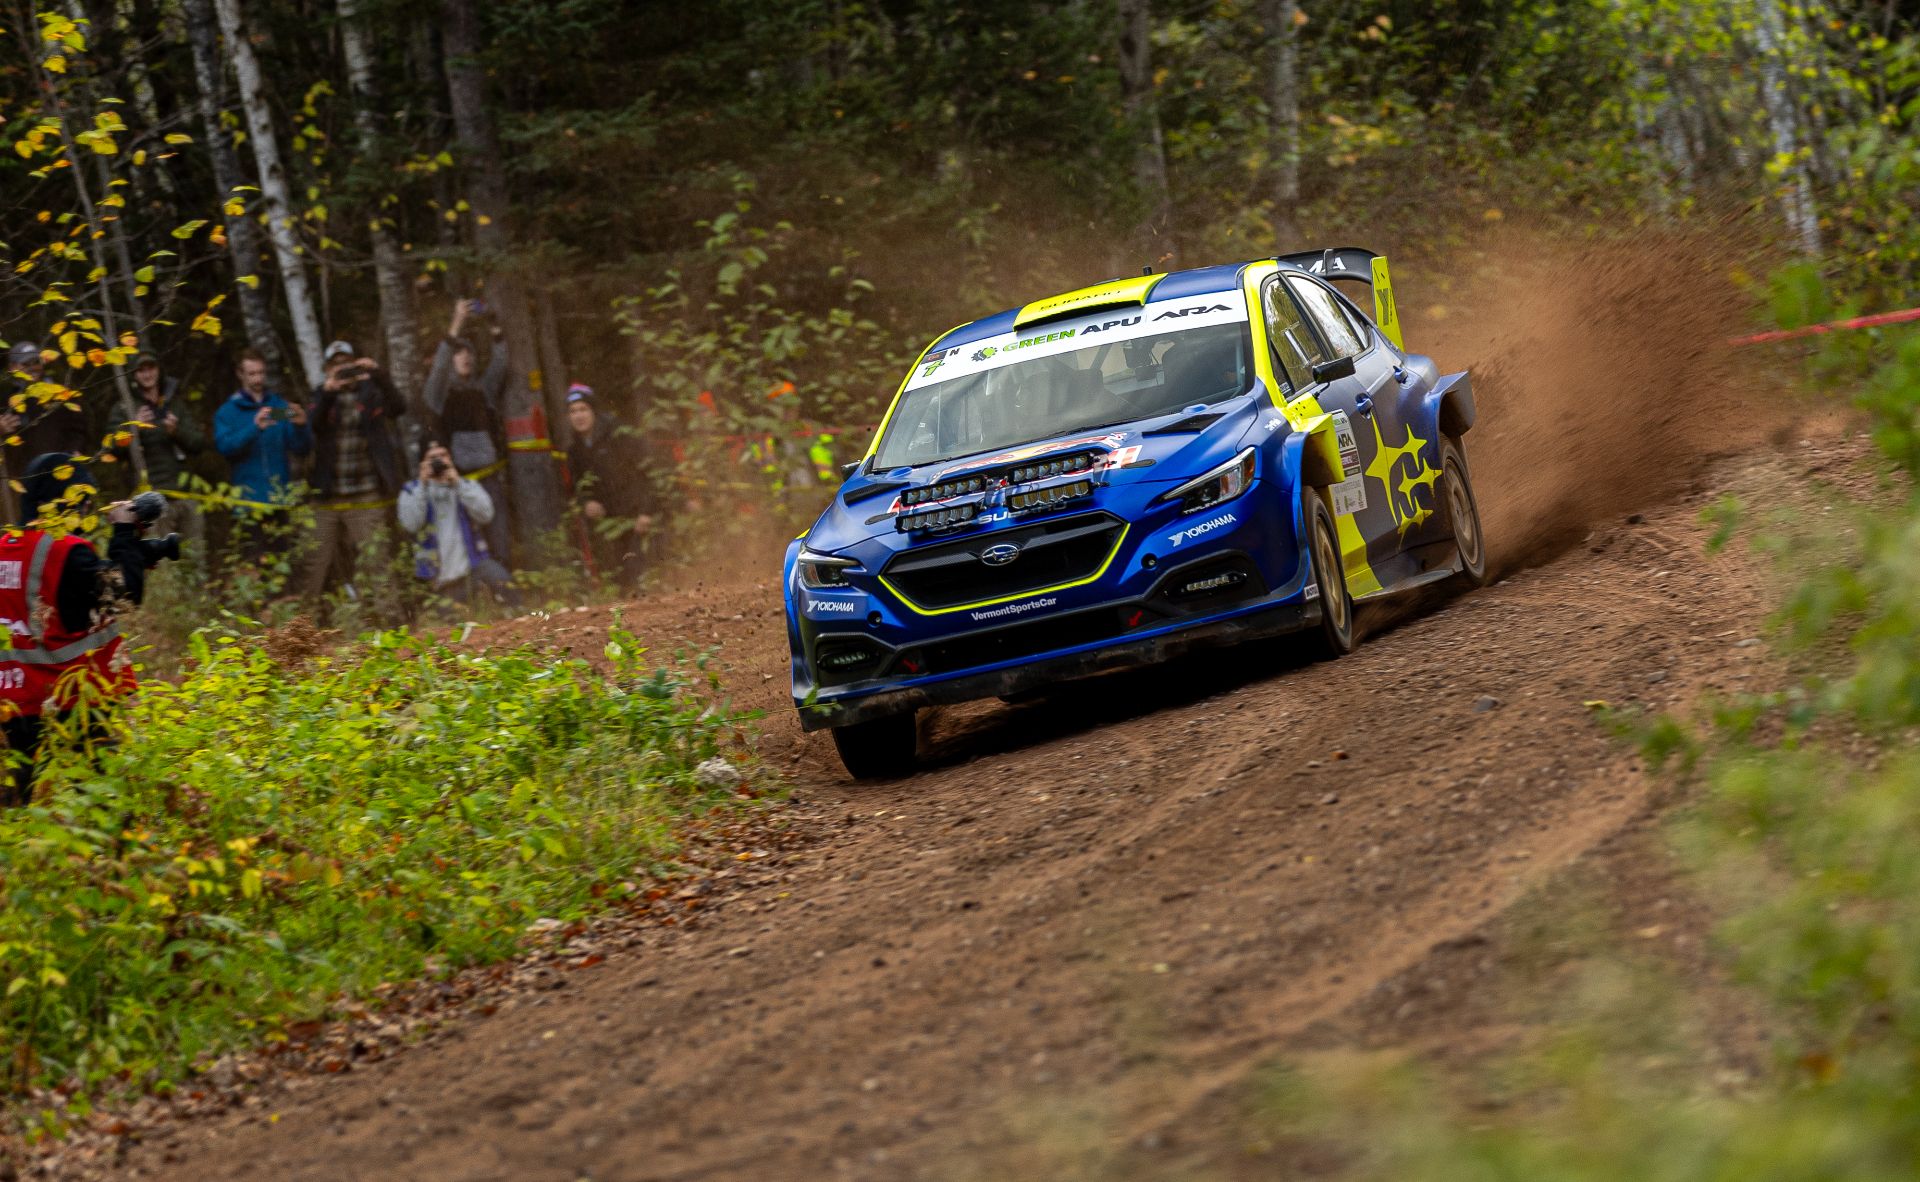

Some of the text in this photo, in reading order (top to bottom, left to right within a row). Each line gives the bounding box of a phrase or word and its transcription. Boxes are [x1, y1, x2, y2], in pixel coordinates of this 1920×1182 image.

[1002, 304, 1233, 352] GREEN APU ARA
[949, 348, 961, 356] N
[1183, 513, 1237, 539] YOKOHAMA
[817, 600, 854, 612] YOKOHAMA
[971, 597, 1057, 621] VermontSportsCar
